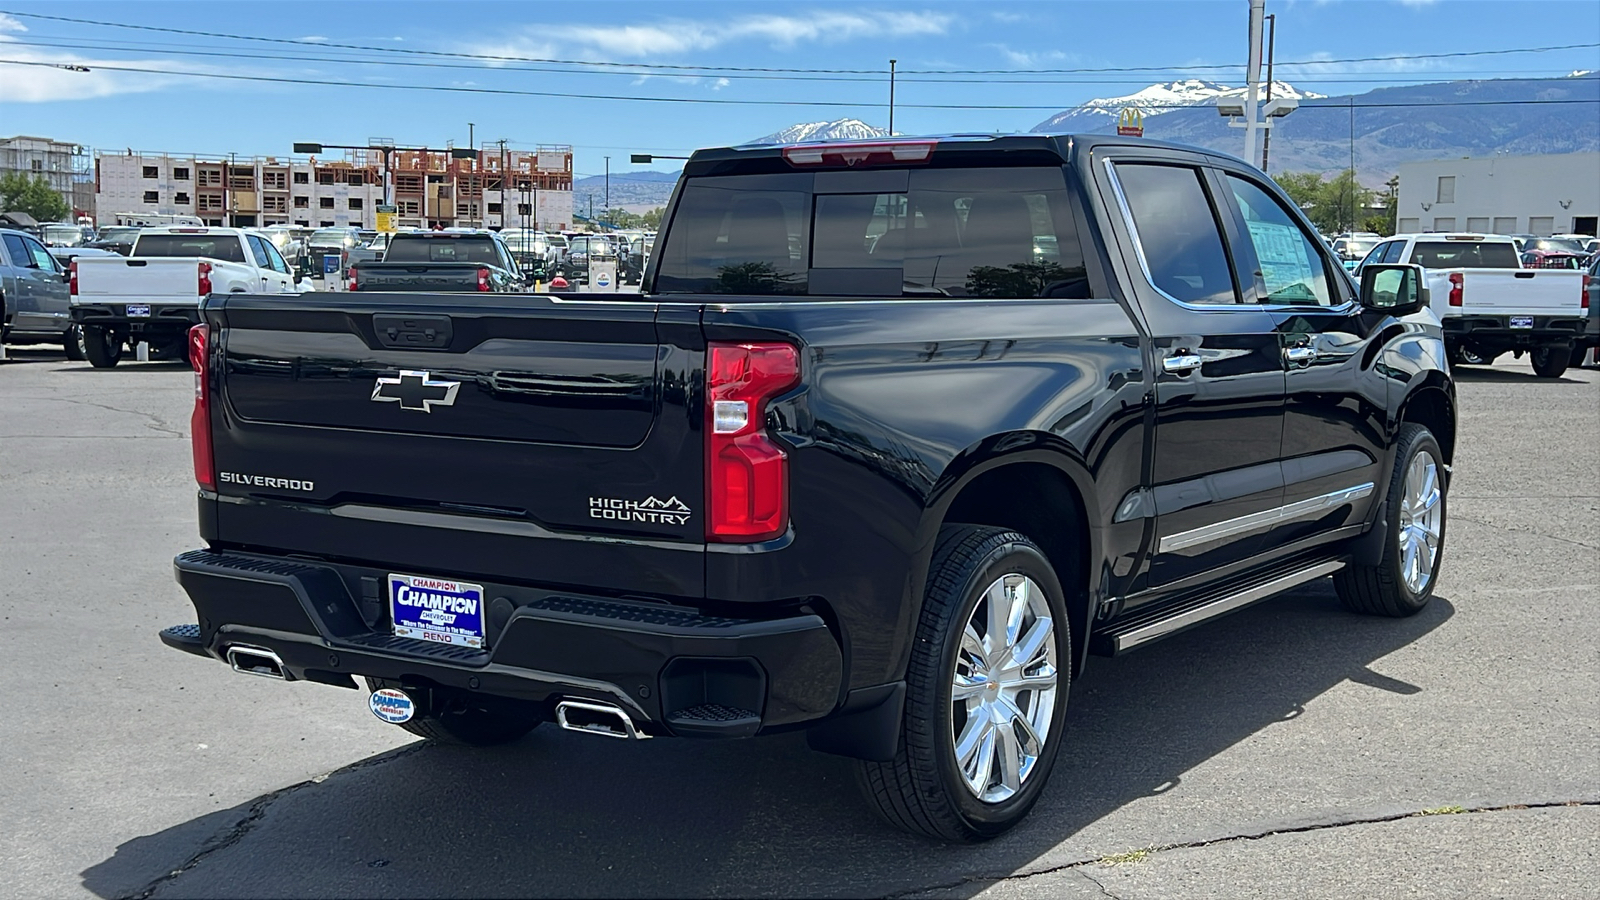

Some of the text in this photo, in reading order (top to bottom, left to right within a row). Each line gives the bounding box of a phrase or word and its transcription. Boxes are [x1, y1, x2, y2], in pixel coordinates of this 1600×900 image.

[220, 472, 314, 491] SILVERADO
[589, 497, 638, 510] HIGH
[590, 508, 691, 525] COUNTRY
[413, 579, 457, 591] CHAMPION
[397, 586, 477, 615] CHAMPION
[422, 612, 453, 622] CHEVROLET
[423, 632, 452, 643] RENO
